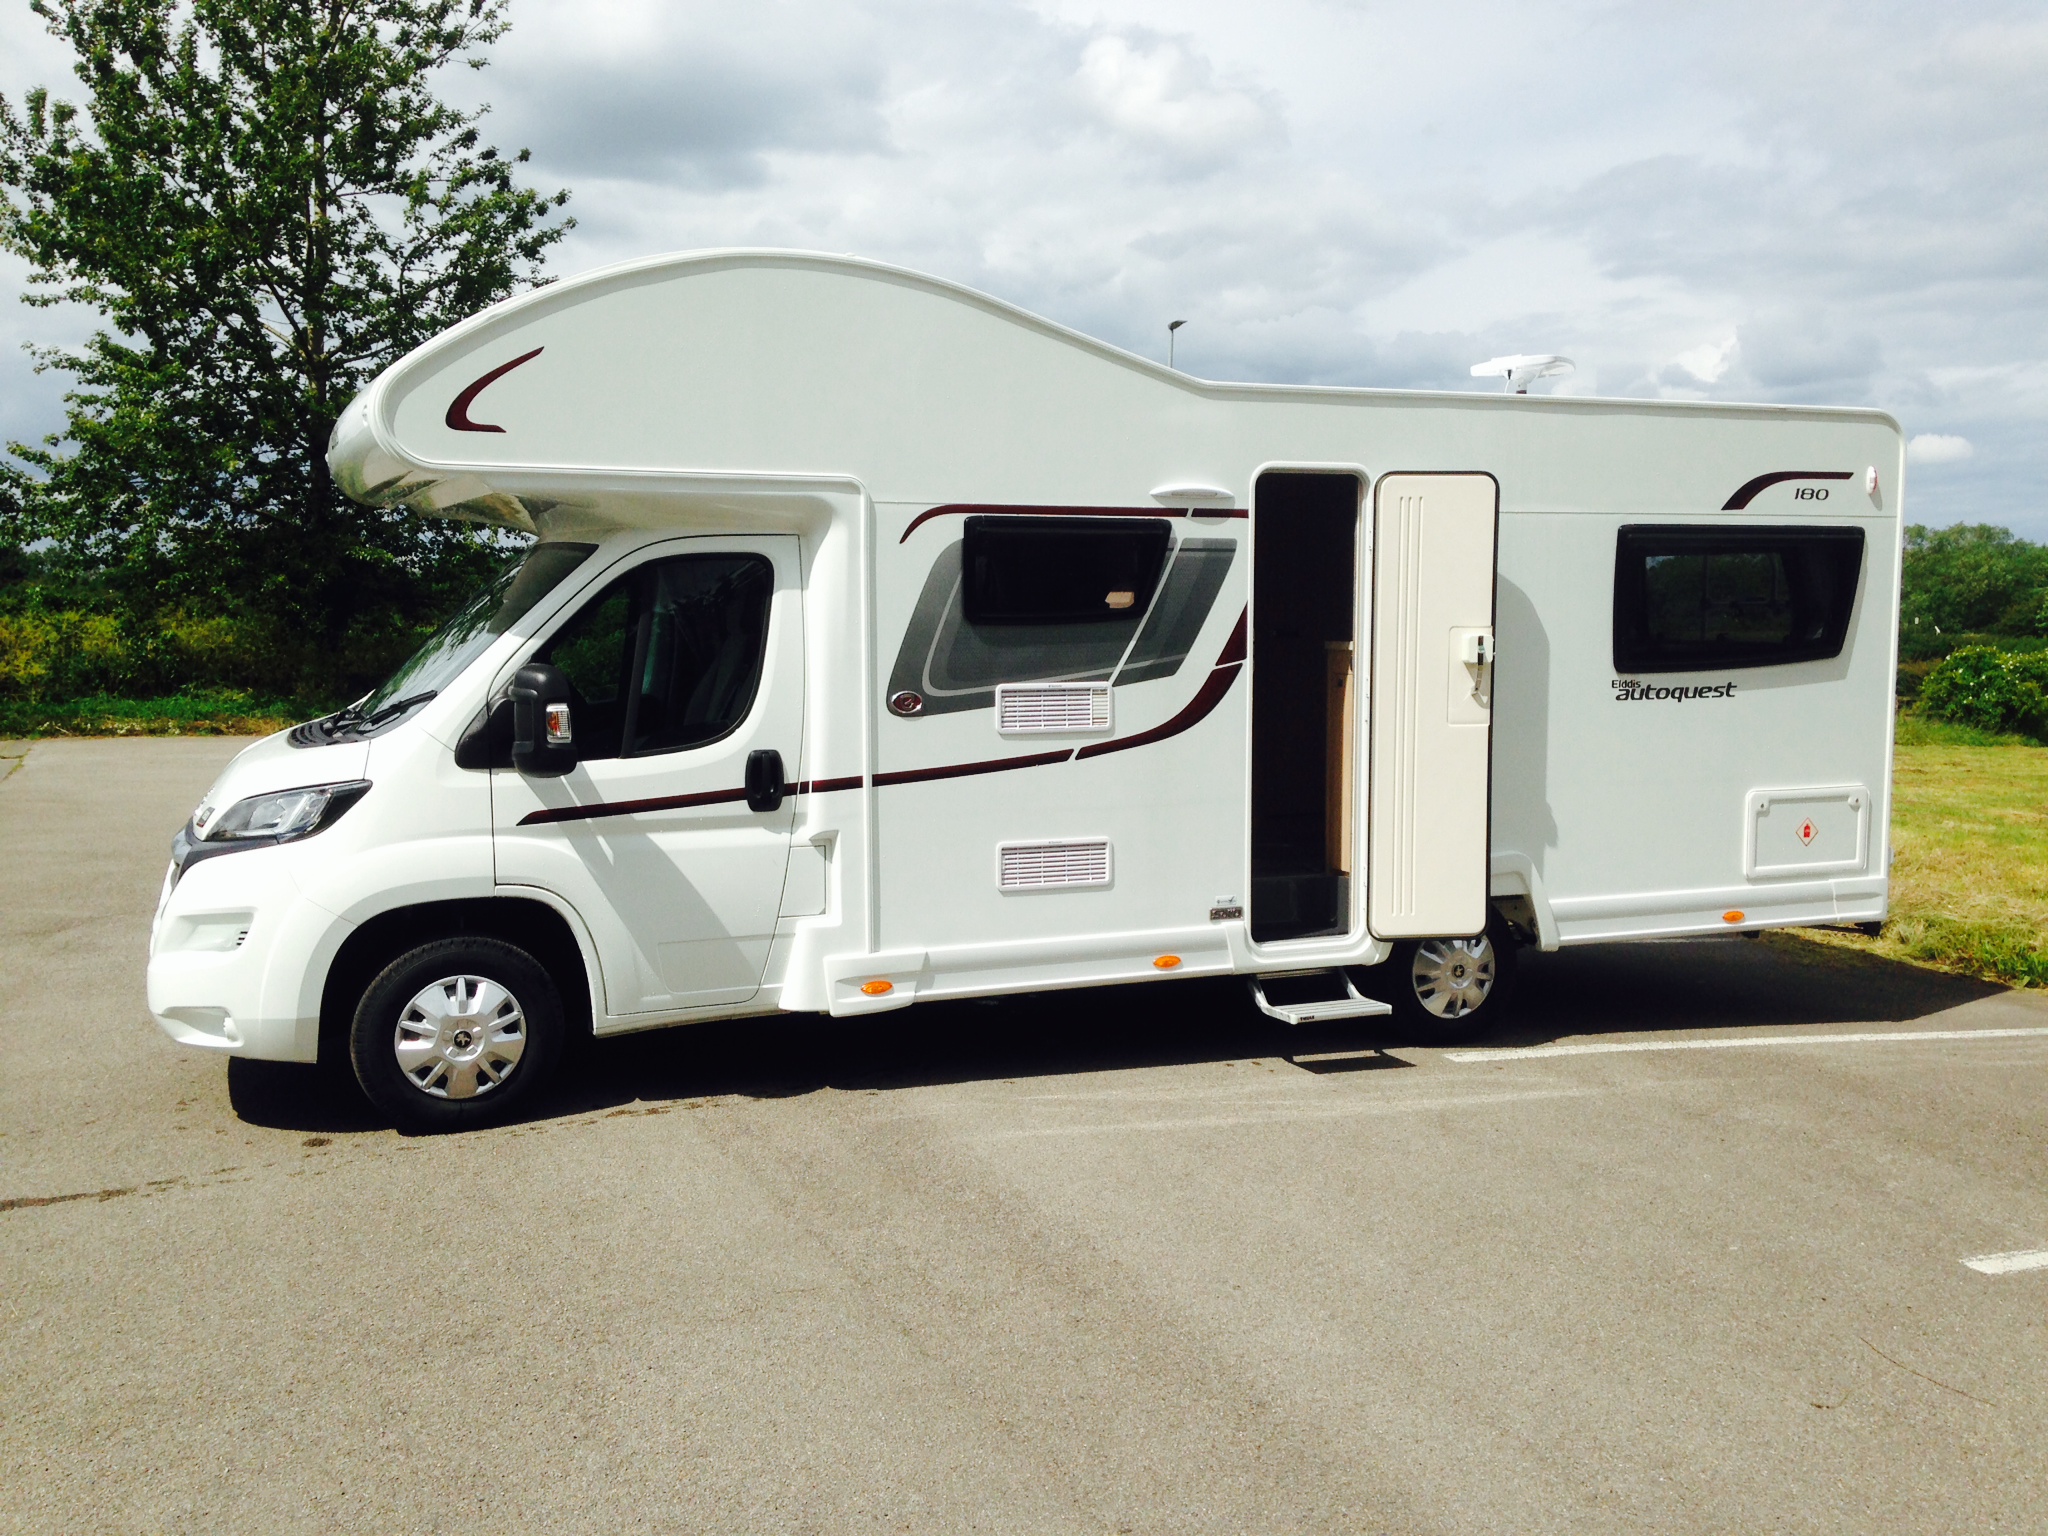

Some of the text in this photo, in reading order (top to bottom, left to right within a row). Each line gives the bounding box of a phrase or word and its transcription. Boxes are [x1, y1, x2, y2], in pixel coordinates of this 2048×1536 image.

[1795, 488, 1829, 501] 180
[1611, 679, 1641, 689] Elddis
[1615, 682, 1737, 703] autoquest
